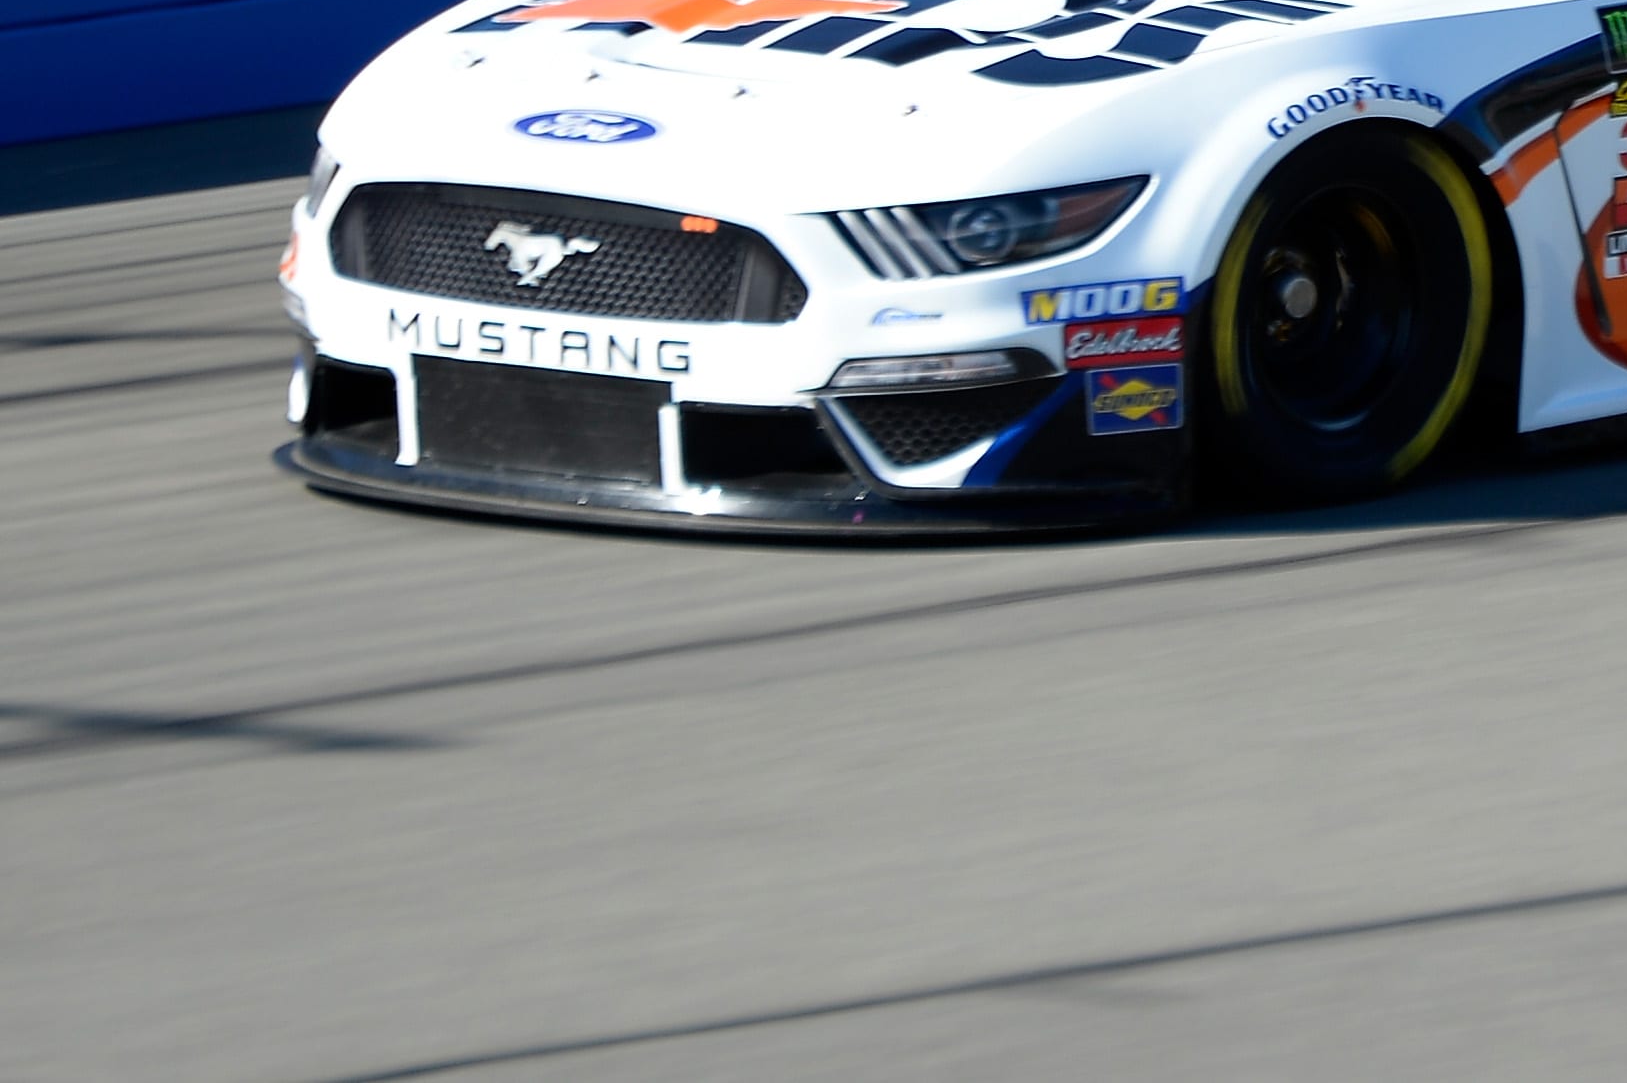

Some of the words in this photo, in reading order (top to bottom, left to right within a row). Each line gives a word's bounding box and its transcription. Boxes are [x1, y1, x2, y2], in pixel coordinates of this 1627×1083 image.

[526, 113, 641, 144] Ford
[1267, 82, 1446, 139] GOODYEAR
[1028, 279, 1179, 323] MOOG
[388, 308, 690, 372] MUSTANG
[1065, 326, 1184, 361] Edelbrock
